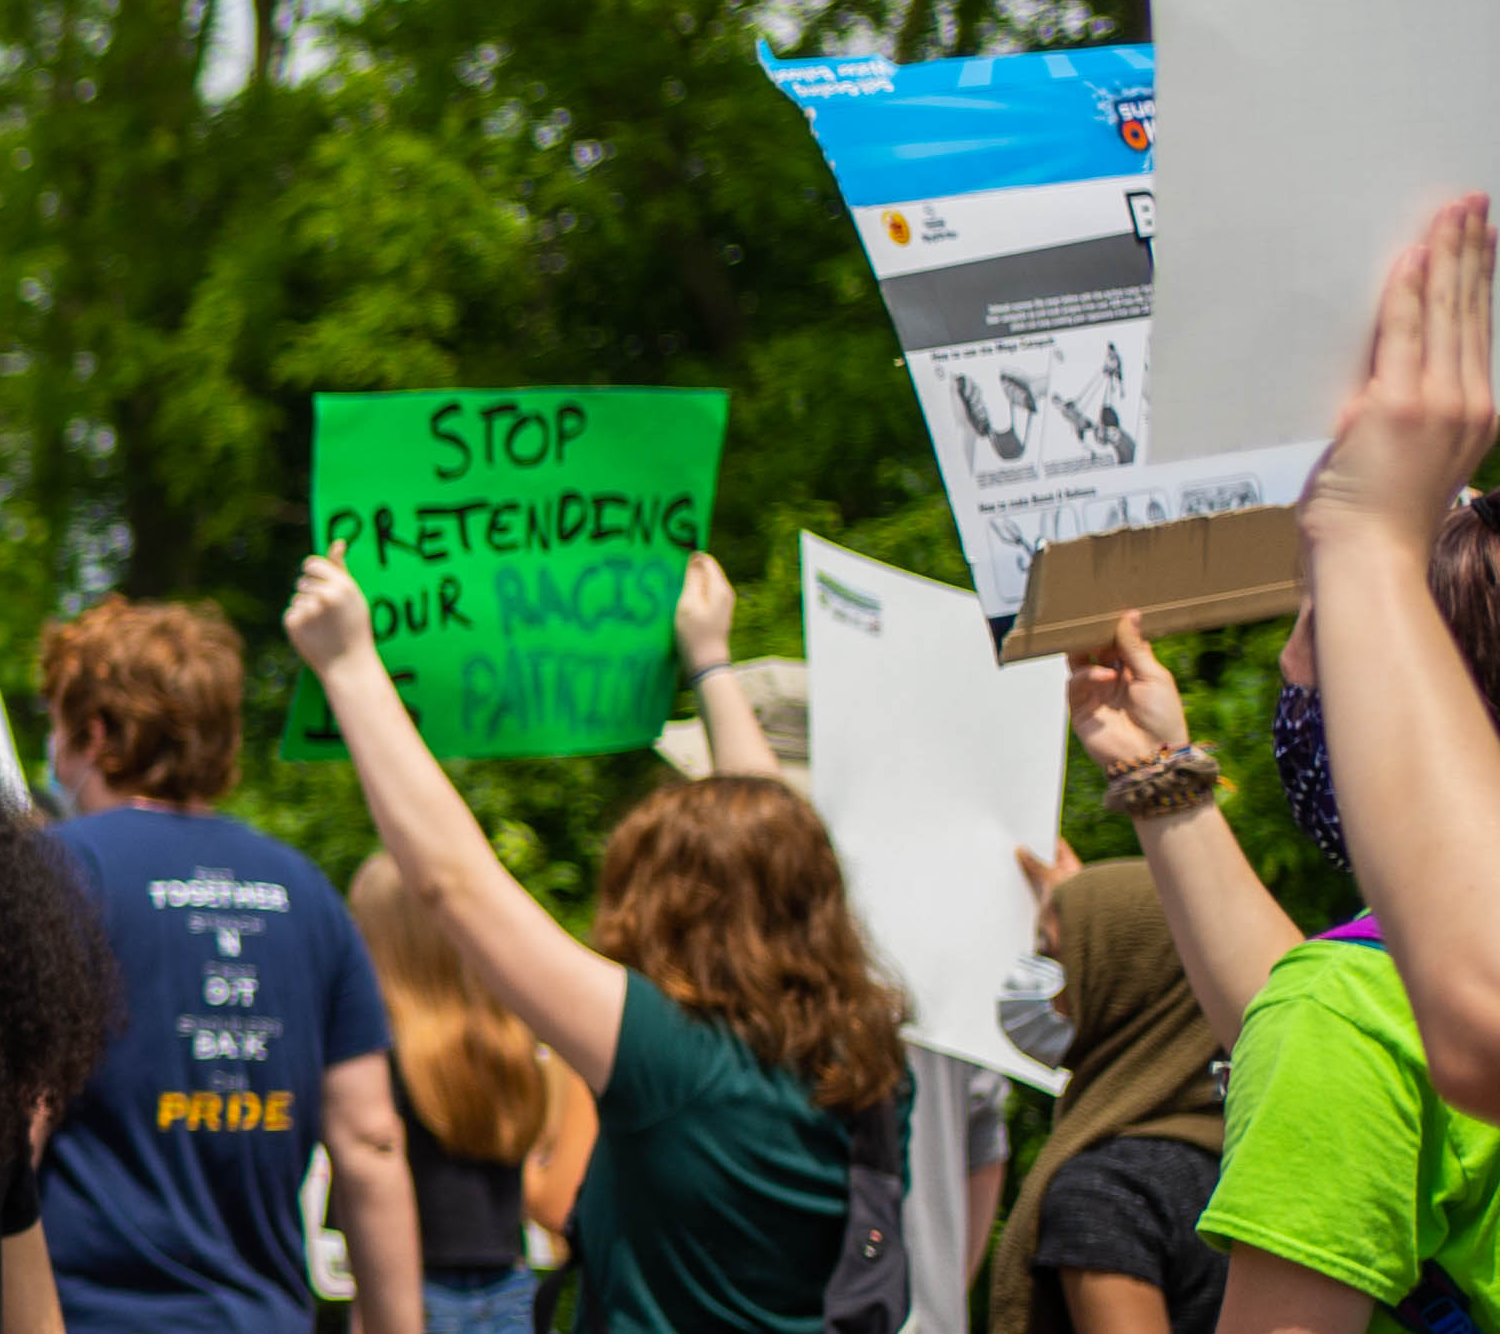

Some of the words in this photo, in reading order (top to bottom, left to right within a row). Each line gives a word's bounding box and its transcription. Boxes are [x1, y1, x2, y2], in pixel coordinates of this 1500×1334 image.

[428, 399, 587, 481] STOP
[326, 491, 700, 567] PRETENDING
[369, 576, 475, 643] OUR
[156, 1091, 294, 1132] PRIDE
